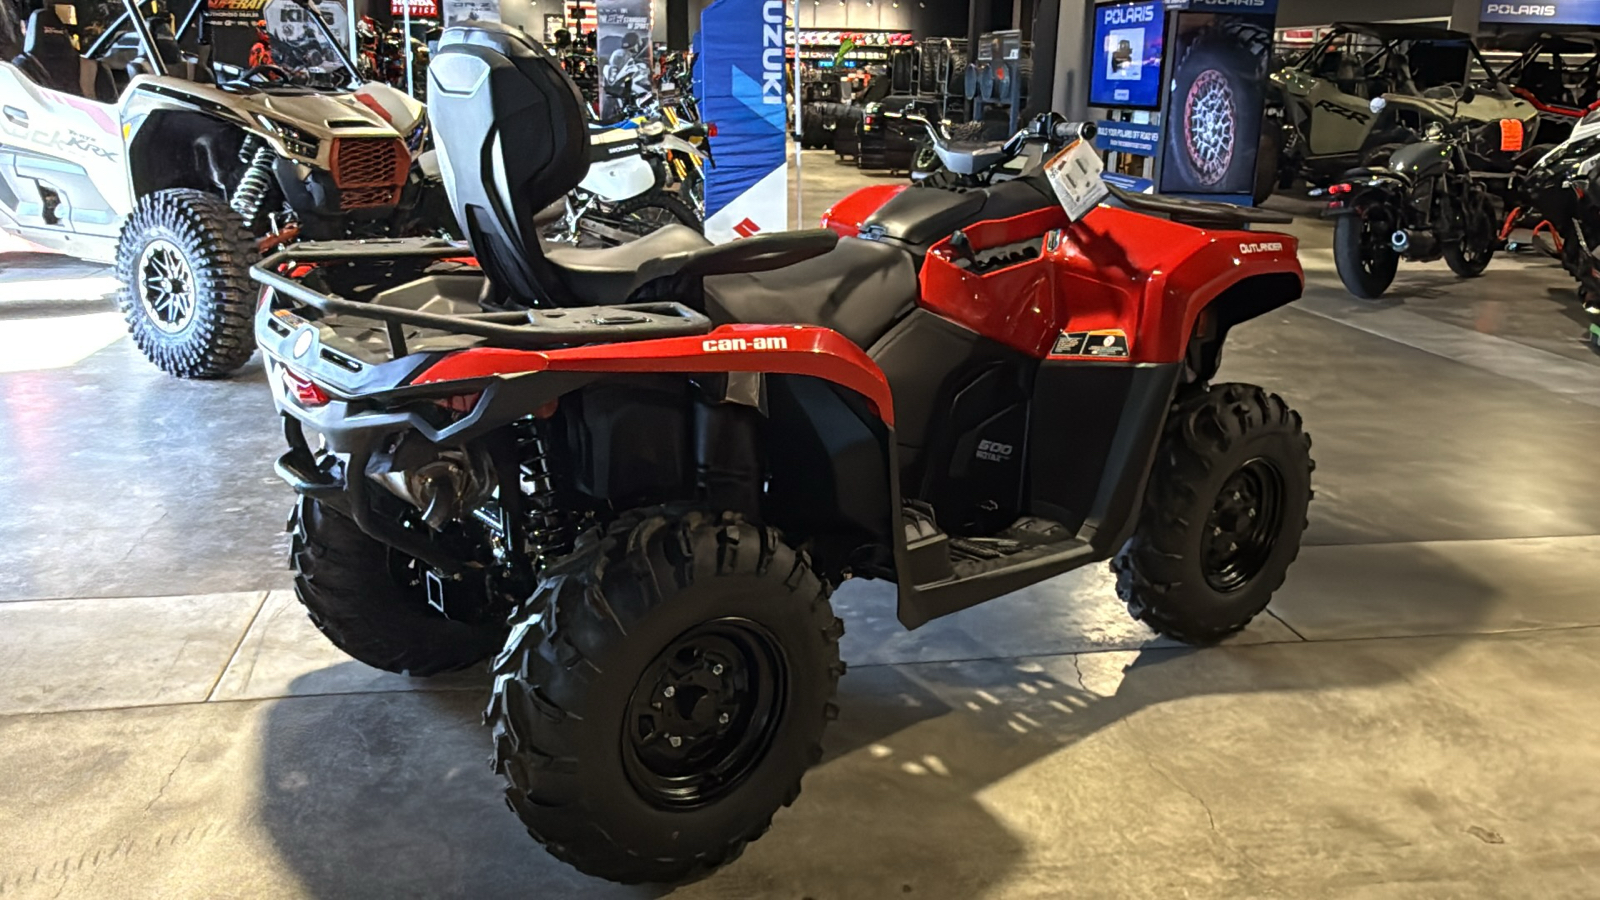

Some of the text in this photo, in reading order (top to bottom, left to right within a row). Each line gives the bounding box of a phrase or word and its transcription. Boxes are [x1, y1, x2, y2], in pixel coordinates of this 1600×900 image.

[1104, 5, 1155, 25] POLARIS
[1487, 4, 1556, 17] POLARIS
[1314, 100, 1370, 125] RZR
[66, 137, 119, 163] KRX
[608, 143, 639, 154] HONDA
[1239, 242, 1283, 254] OUTLANDER
[702, 336, 788, 352] can-am
